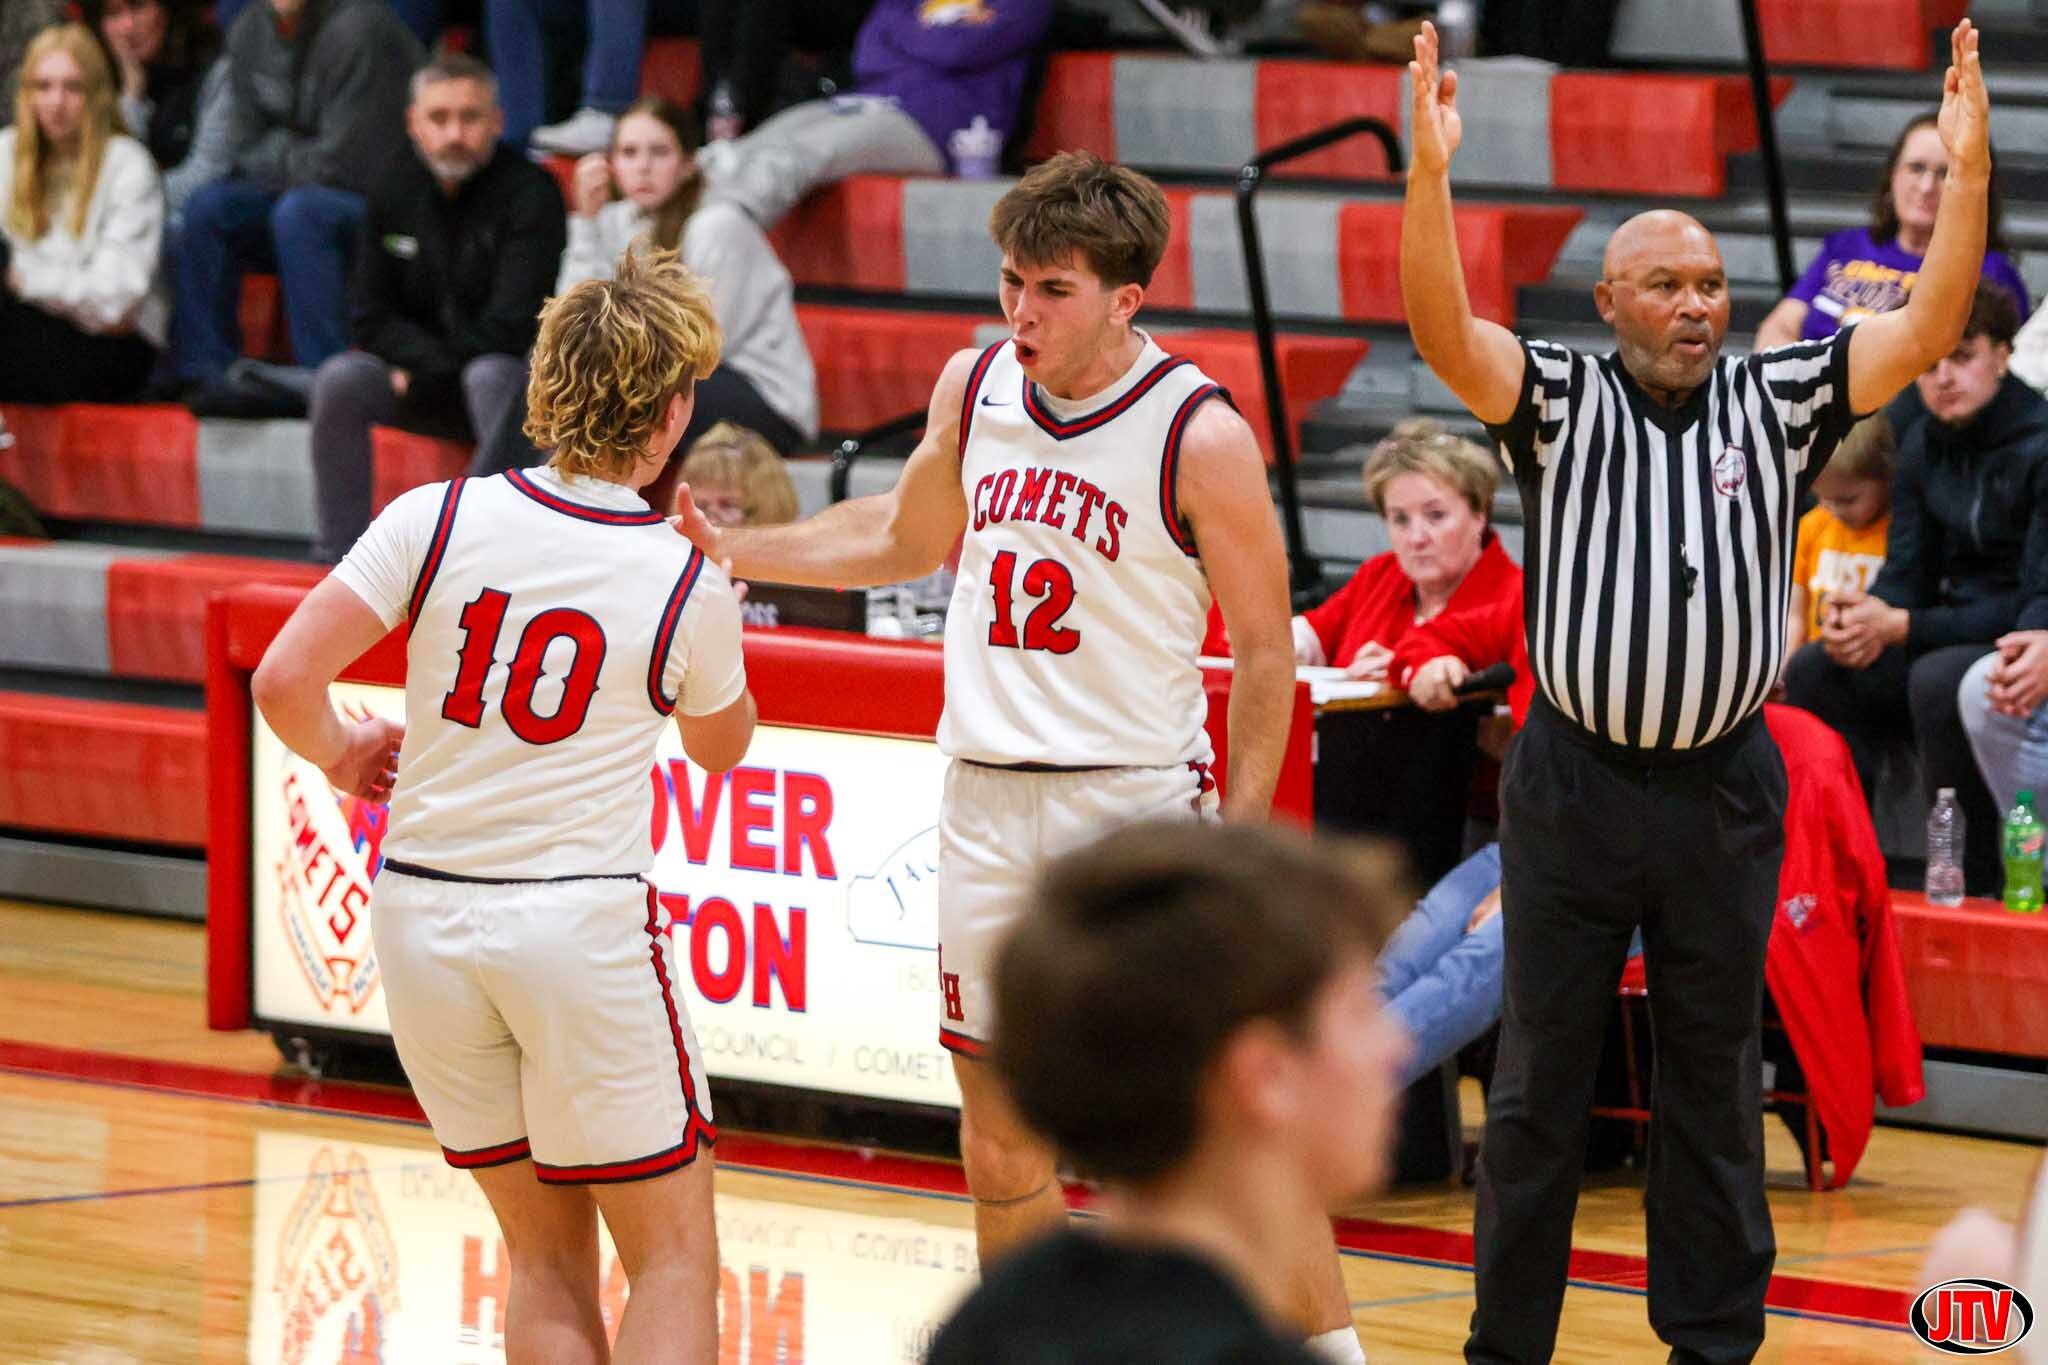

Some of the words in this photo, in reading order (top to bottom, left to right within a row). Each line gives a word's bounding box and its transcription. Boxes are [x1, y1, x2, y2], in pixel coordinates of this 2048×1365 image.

[974, 467, 1128, 562] COMETS
[988, 550, 1081, 655] 12
[441, 586, 608, 746] 10
[284, 772, 370, 945] COMETS
[853, 1044, 946, 1081] COMET
